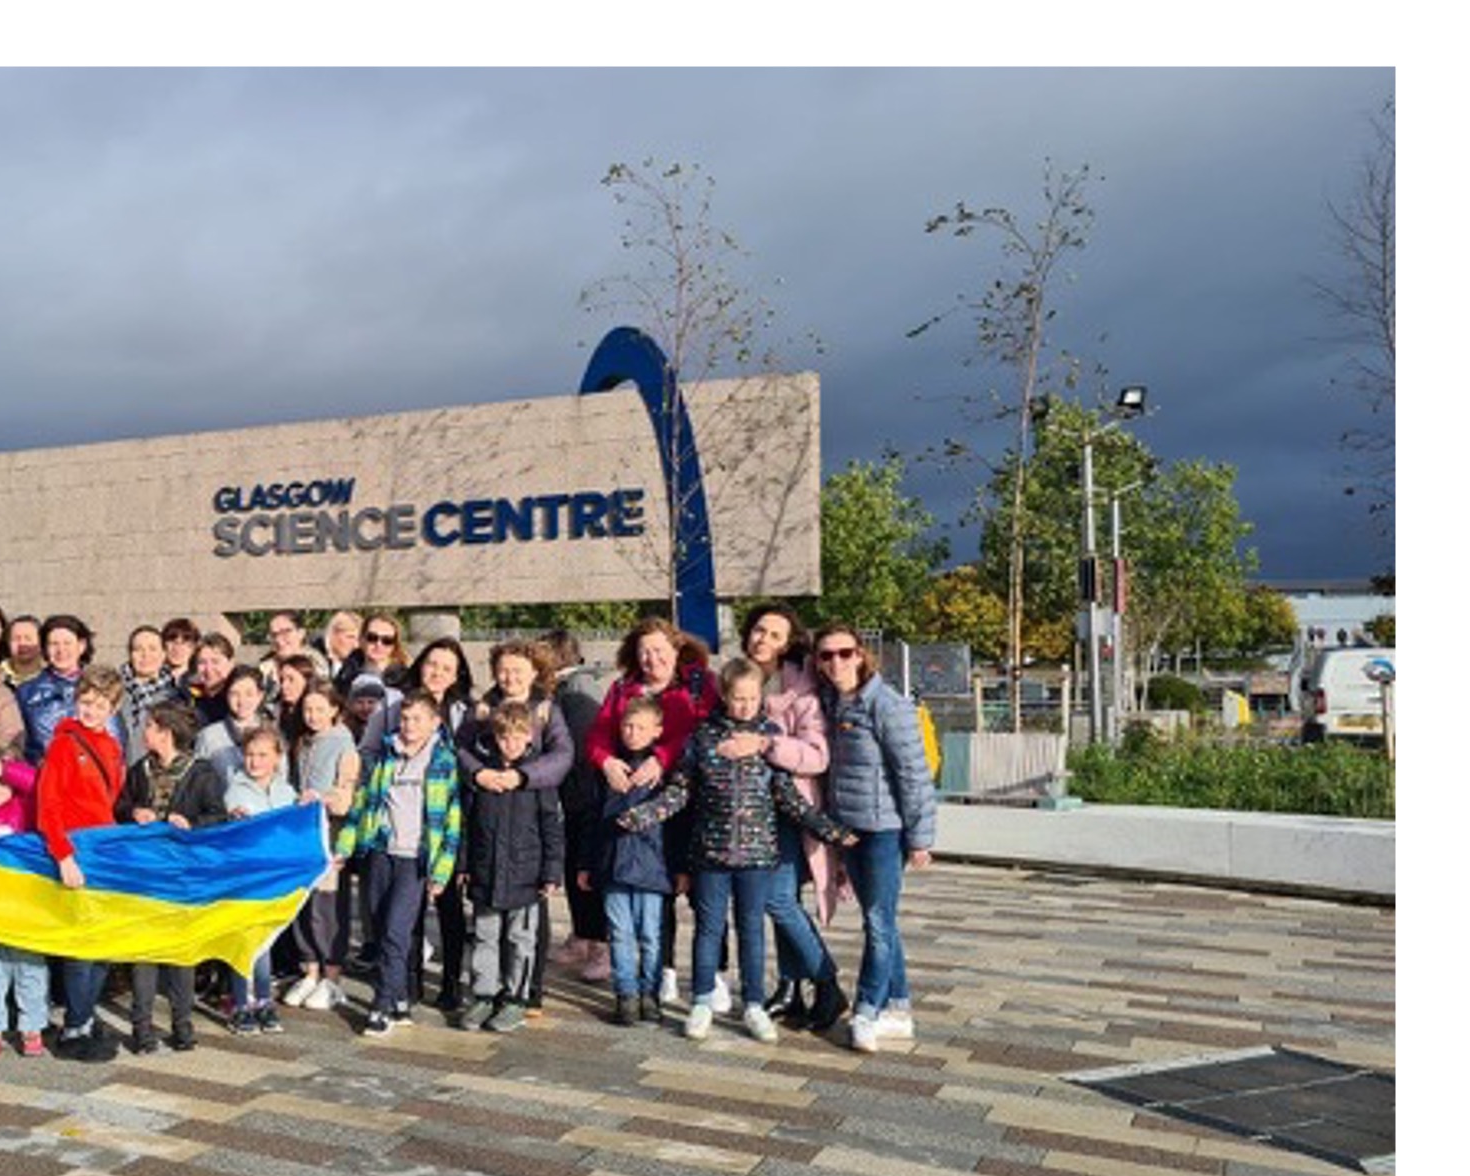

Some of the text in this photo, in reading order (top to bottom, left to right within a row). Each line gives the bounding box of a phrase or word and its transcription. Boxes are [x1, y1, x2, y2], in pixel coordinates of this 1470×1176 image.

[213, 477, 355, 512] GLASGOW
[213, 488, 644, 557] SCIENCE CENTRE
